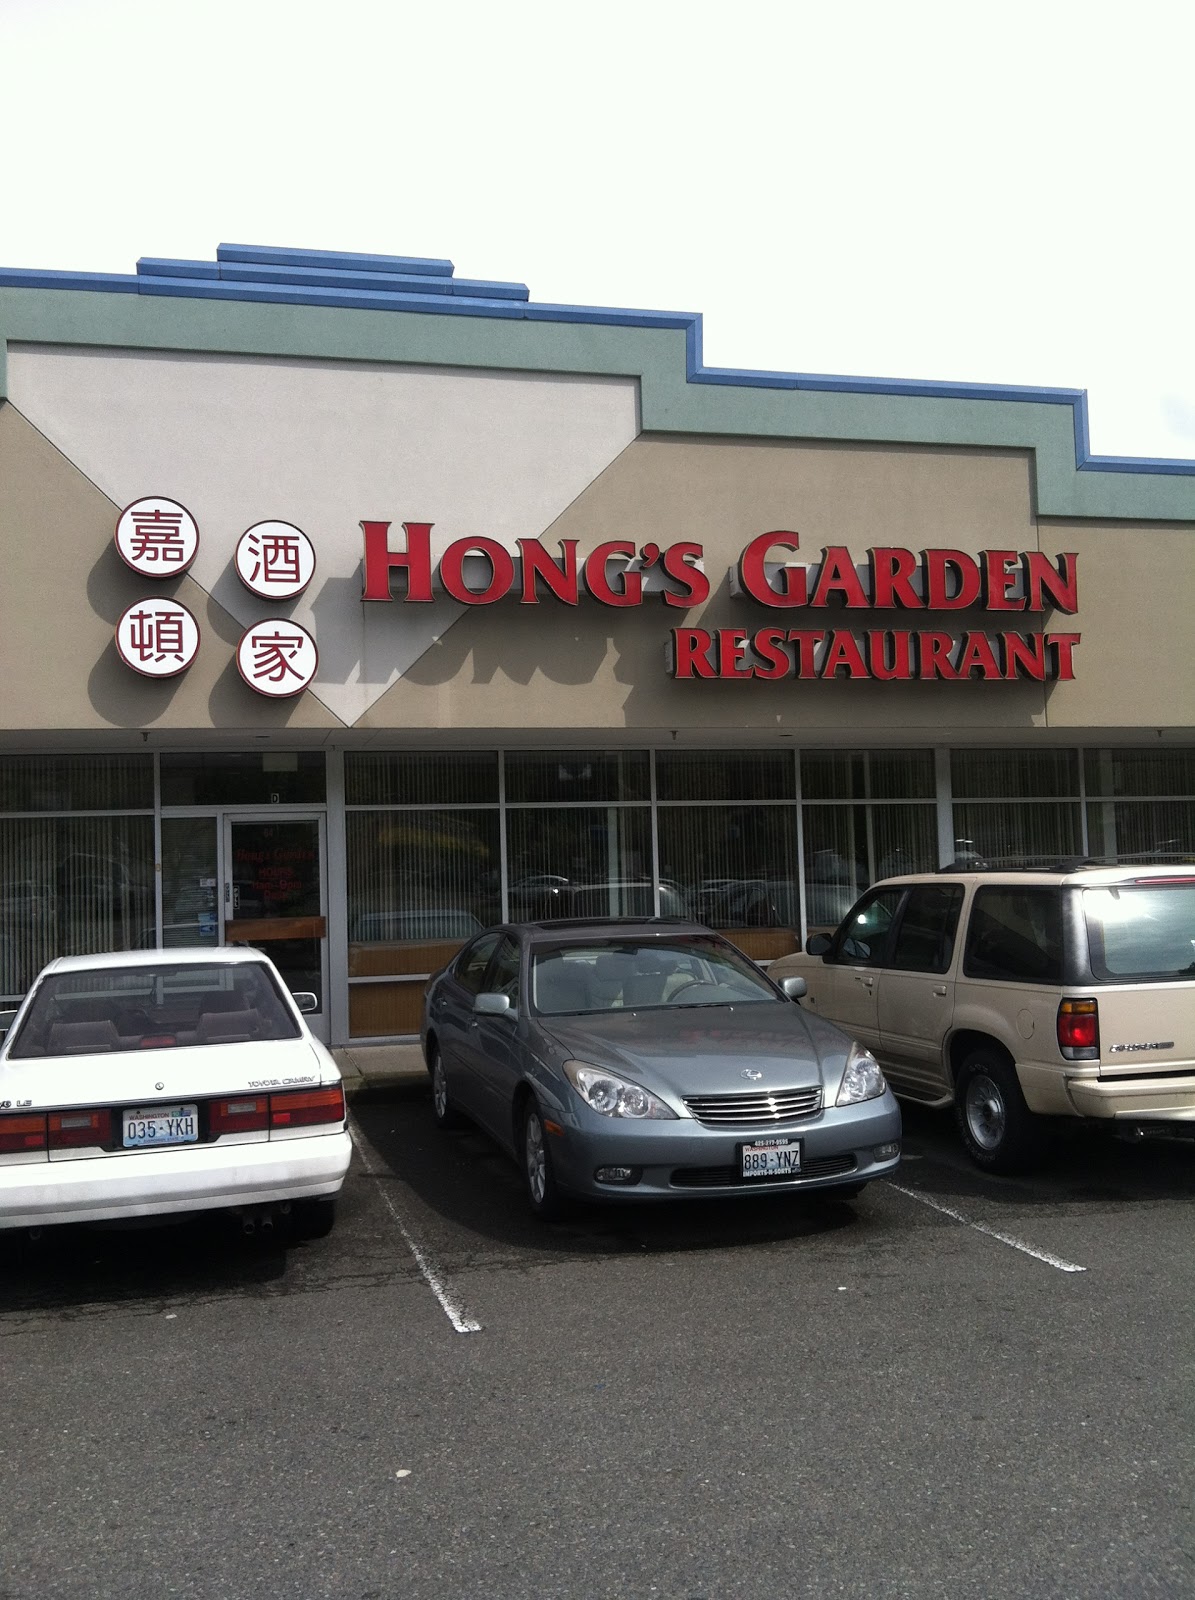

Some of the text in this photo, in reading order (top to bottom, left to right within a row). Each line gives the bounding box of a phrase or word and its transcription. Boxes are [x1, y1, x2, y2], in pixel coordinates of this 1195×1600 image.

[130, 509, 185, 562] 嘉
[248, 533, 300, 583] 酒
[359, 520, 1079, 615] HONG'S GARDEN
[251, 631, 305, 682] 家
[671, 627, 1081, 681] RESTAURANT
[272, 794, 279, 803] D
[128, 1112, 170, 1120] WASHINGTON
